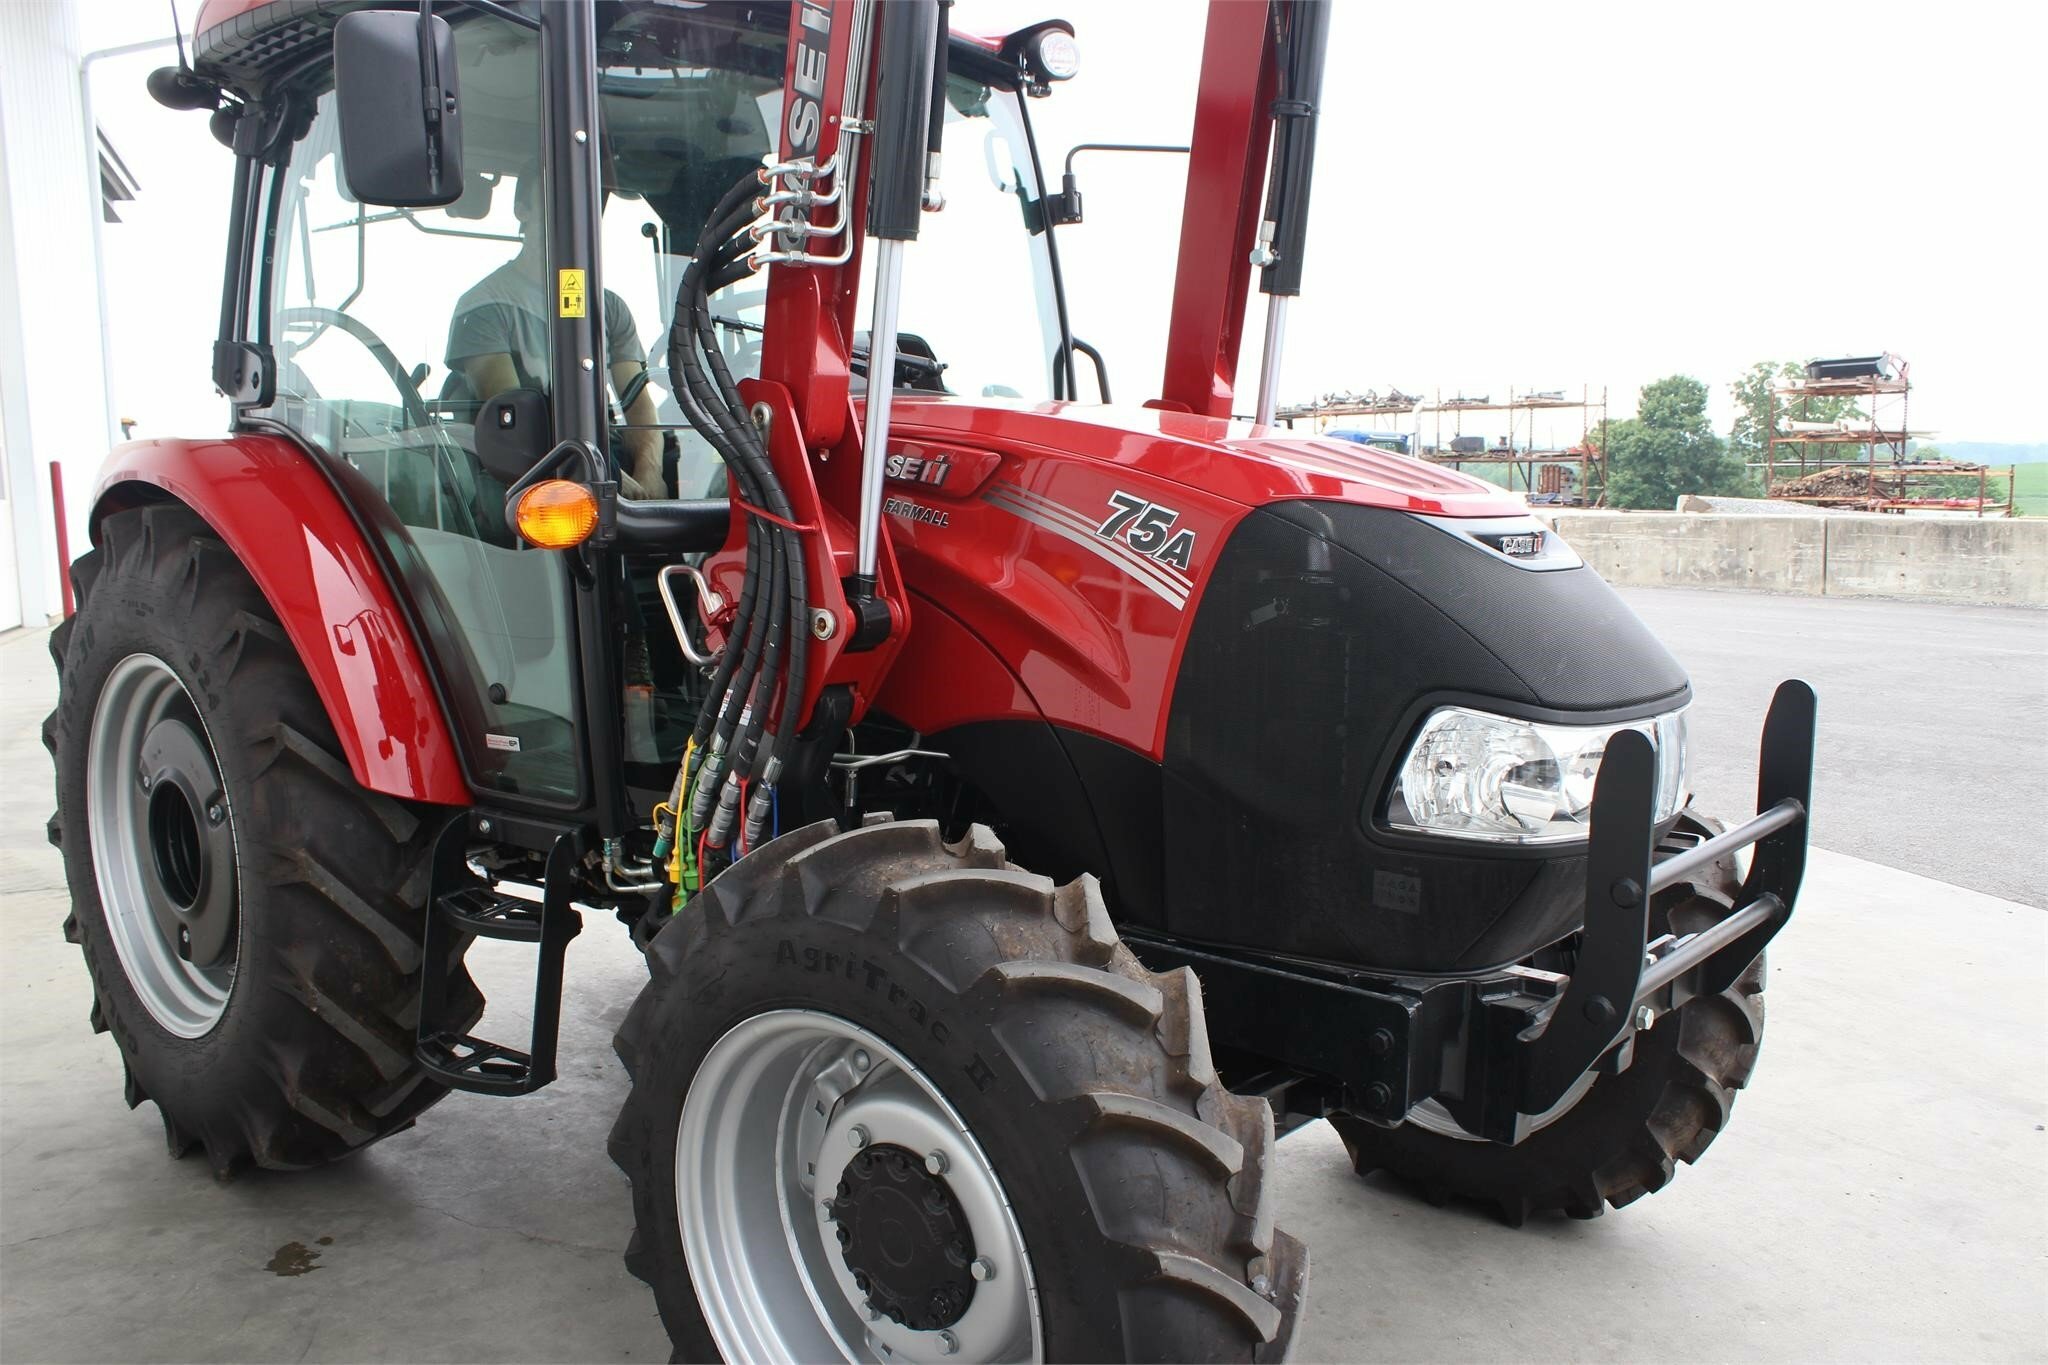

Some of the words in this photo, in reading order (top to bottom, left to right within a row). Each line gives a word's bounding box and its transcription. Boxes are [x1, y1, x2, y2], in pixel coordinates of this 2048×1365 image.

[885, 454, 923, 480] SE
[882, 497, 950, 529] FARMALL
[1096, 490, 1196, 571] 75A
[1502, 537, 1533, 554] CASE
[776, 940, 950, 1046] AgriTrac
